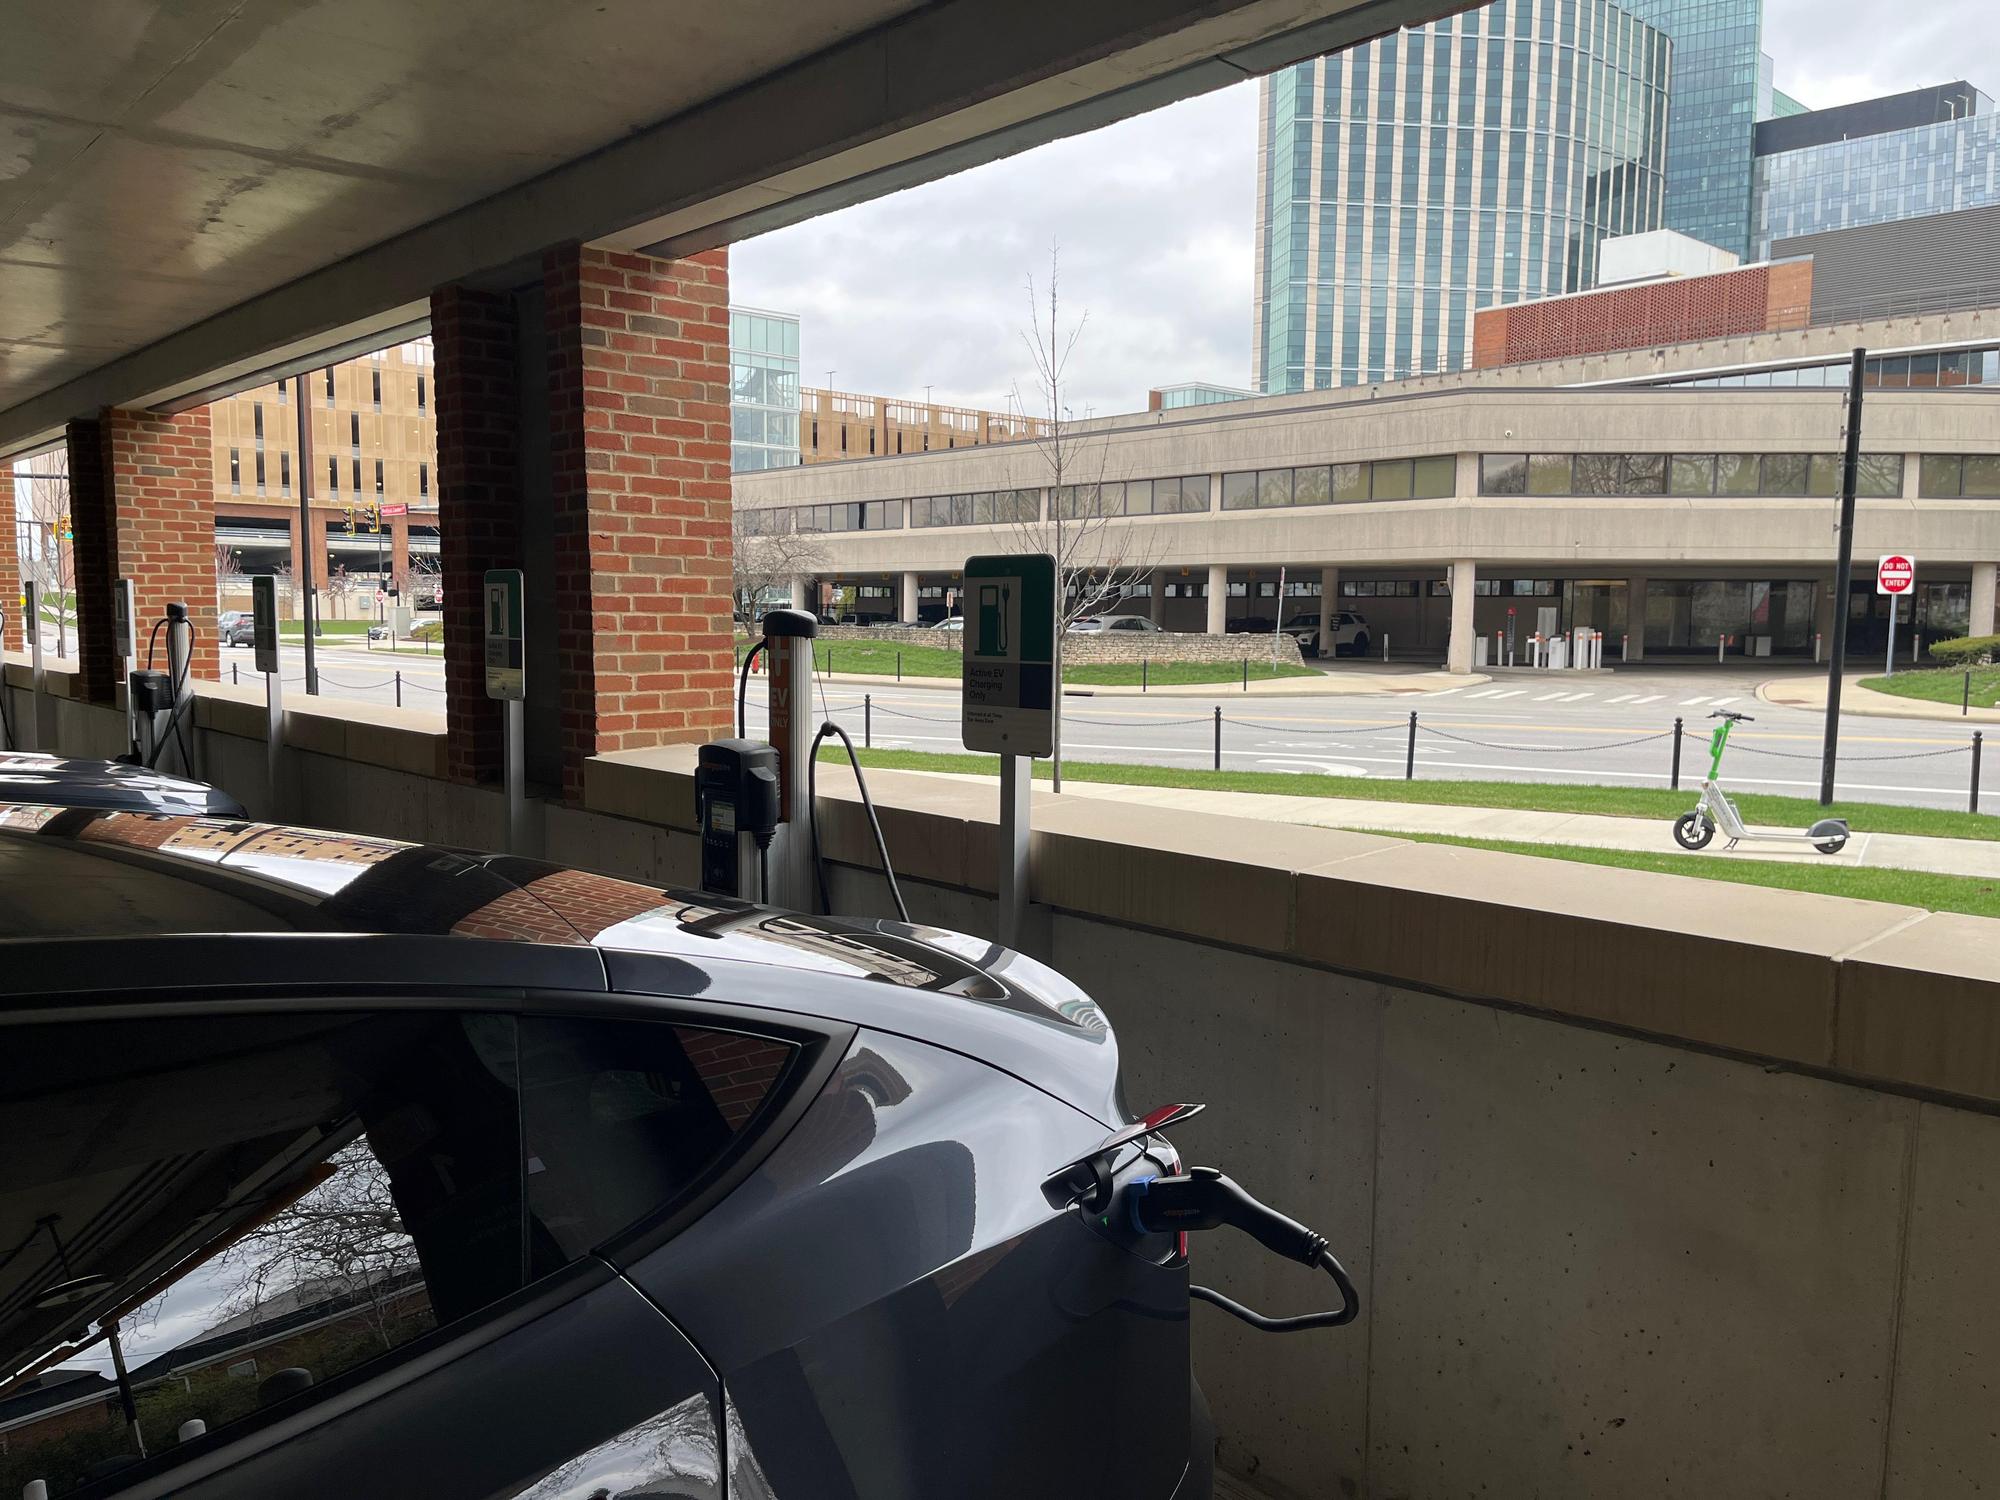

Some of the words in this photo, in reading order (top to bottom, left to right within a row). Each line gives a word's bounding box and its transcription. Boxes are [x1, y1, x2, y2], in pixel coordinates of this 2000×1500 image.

[1884, 562, 1893, 570] DO
[1896, 562, 1908, 570] NOT
[1885, 579, 1906, 587] ENTER
[970, 667, 992, 678] Active
[993, 668, 1005, 678] EV
[969, 679, 1003, 692] Charging
[770, 687, 788, 707] EV
[969, 690, 986, 701] Only
